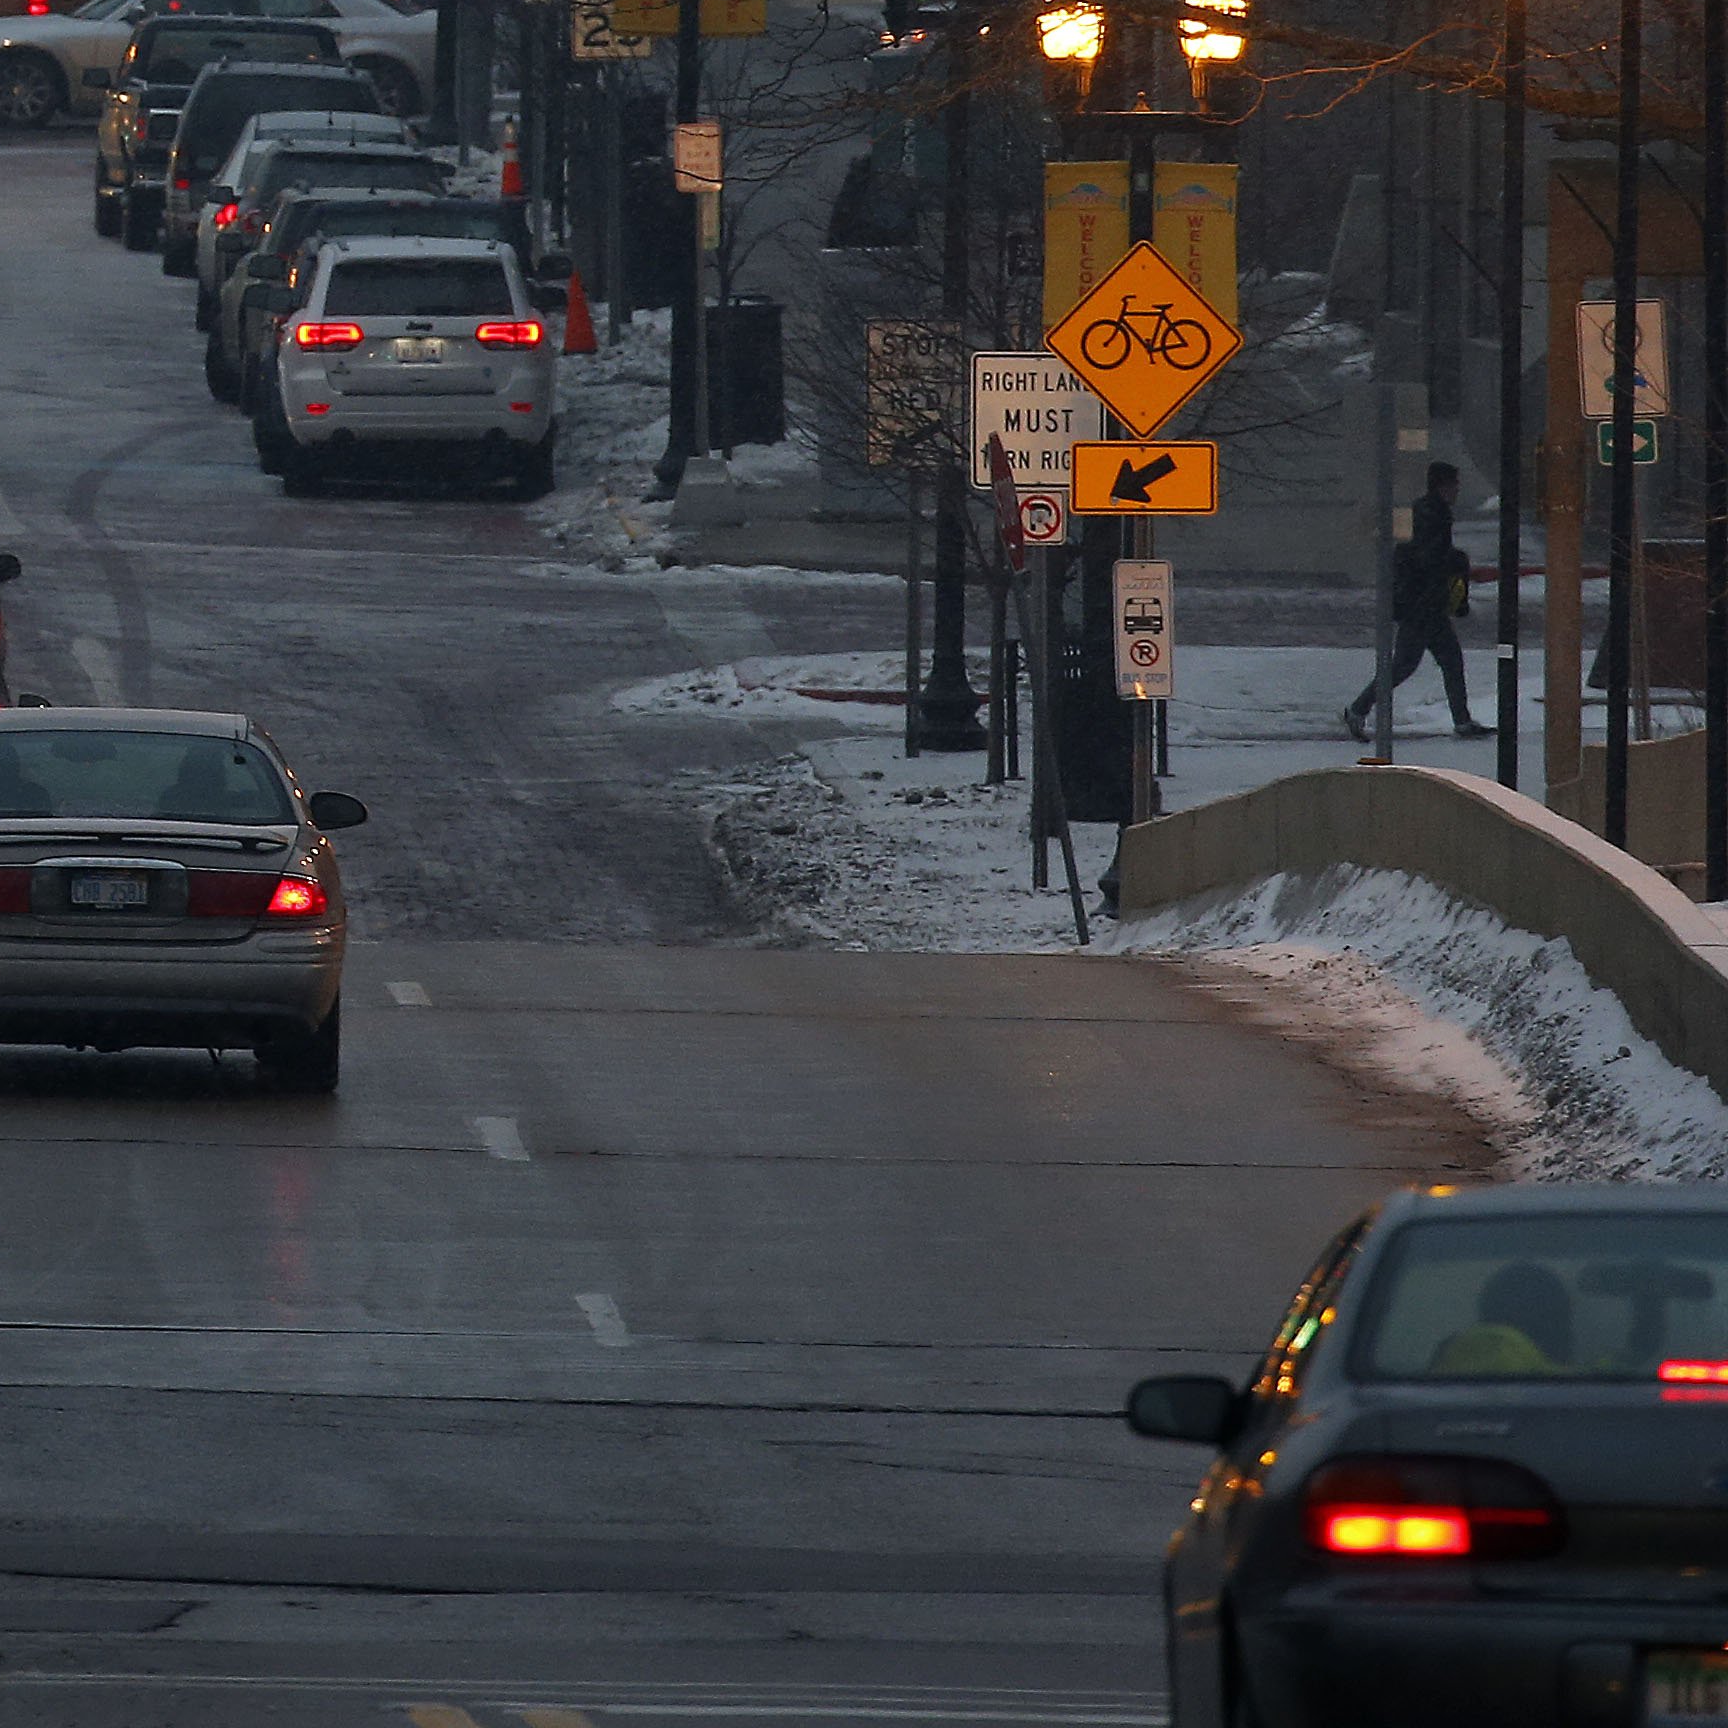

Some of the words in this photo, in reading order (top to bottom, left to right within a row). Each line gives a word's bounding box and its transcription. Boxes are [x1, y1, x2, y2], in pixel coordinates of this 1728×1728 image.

[1187, 214, 1204, 294] WELCO
[982, 372, 1037, 392] RIGHT
[1004, 408, 1074, 433] MUST
[1041, 450, 1071, 470] RIG
[1144, 673, 1168, 684] STOP
